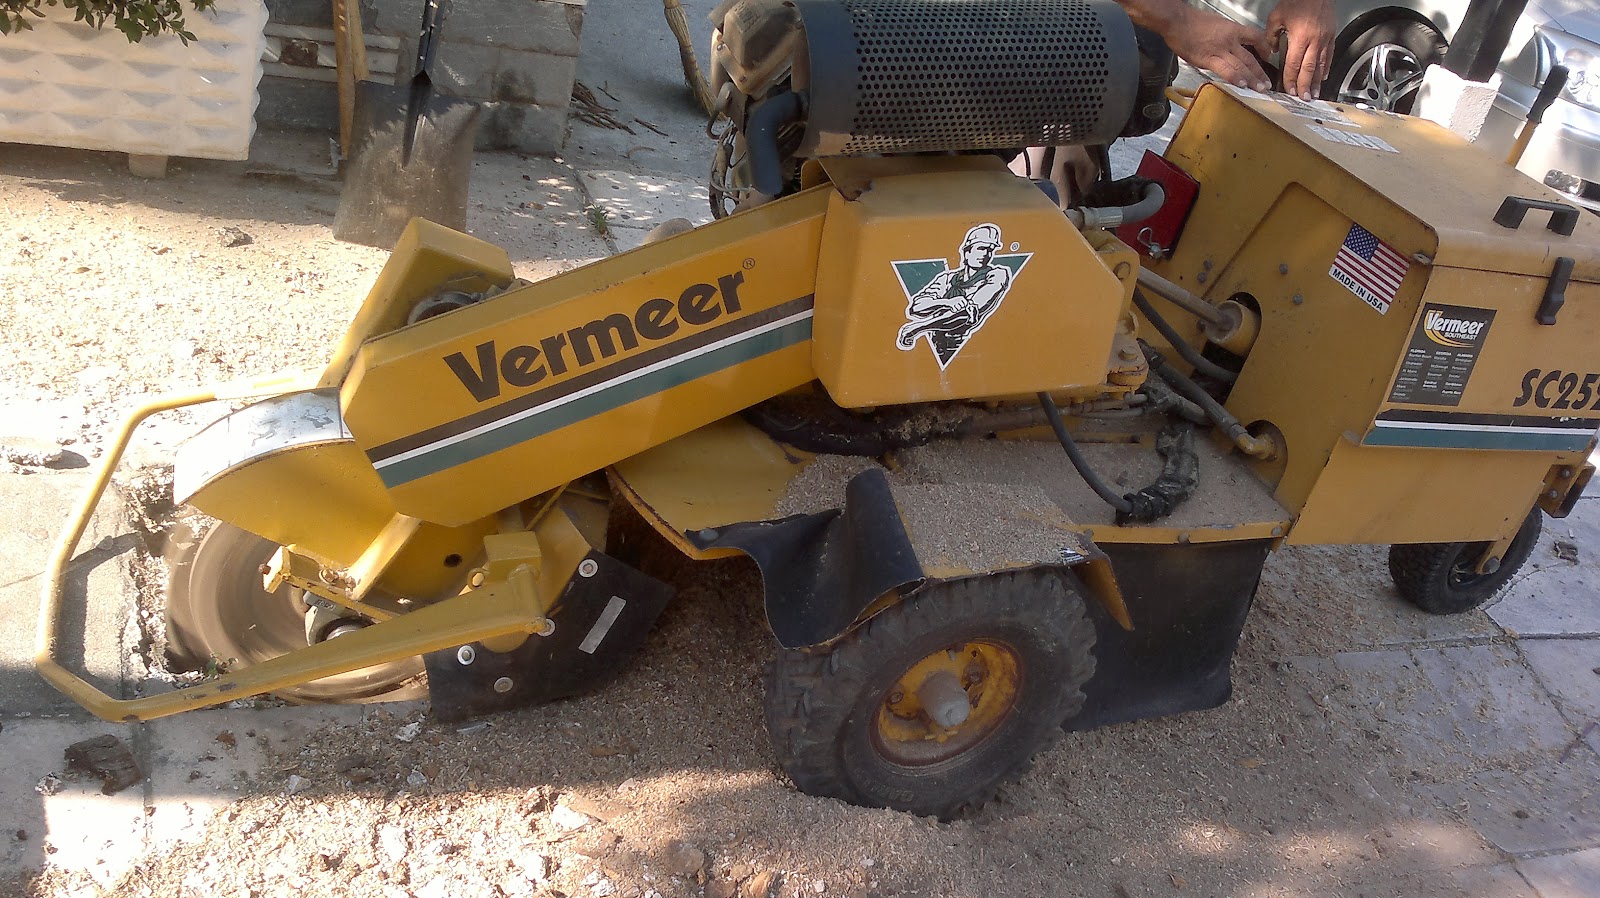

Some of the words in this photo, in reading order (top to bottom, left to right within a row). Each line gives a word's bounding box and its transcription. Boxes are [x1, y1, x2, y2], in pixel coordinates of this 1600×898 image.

[1332, 268, 1356, 290] MADE
[1355, 285, 1367, 298] IN
[1366, 293, 1383, 311] USA
[443, 271, 745, 403] Vermeer
[1426, 312, 1485, 335] Vermeer
[1444, 332, 1478, 341] SOUTHEAST
